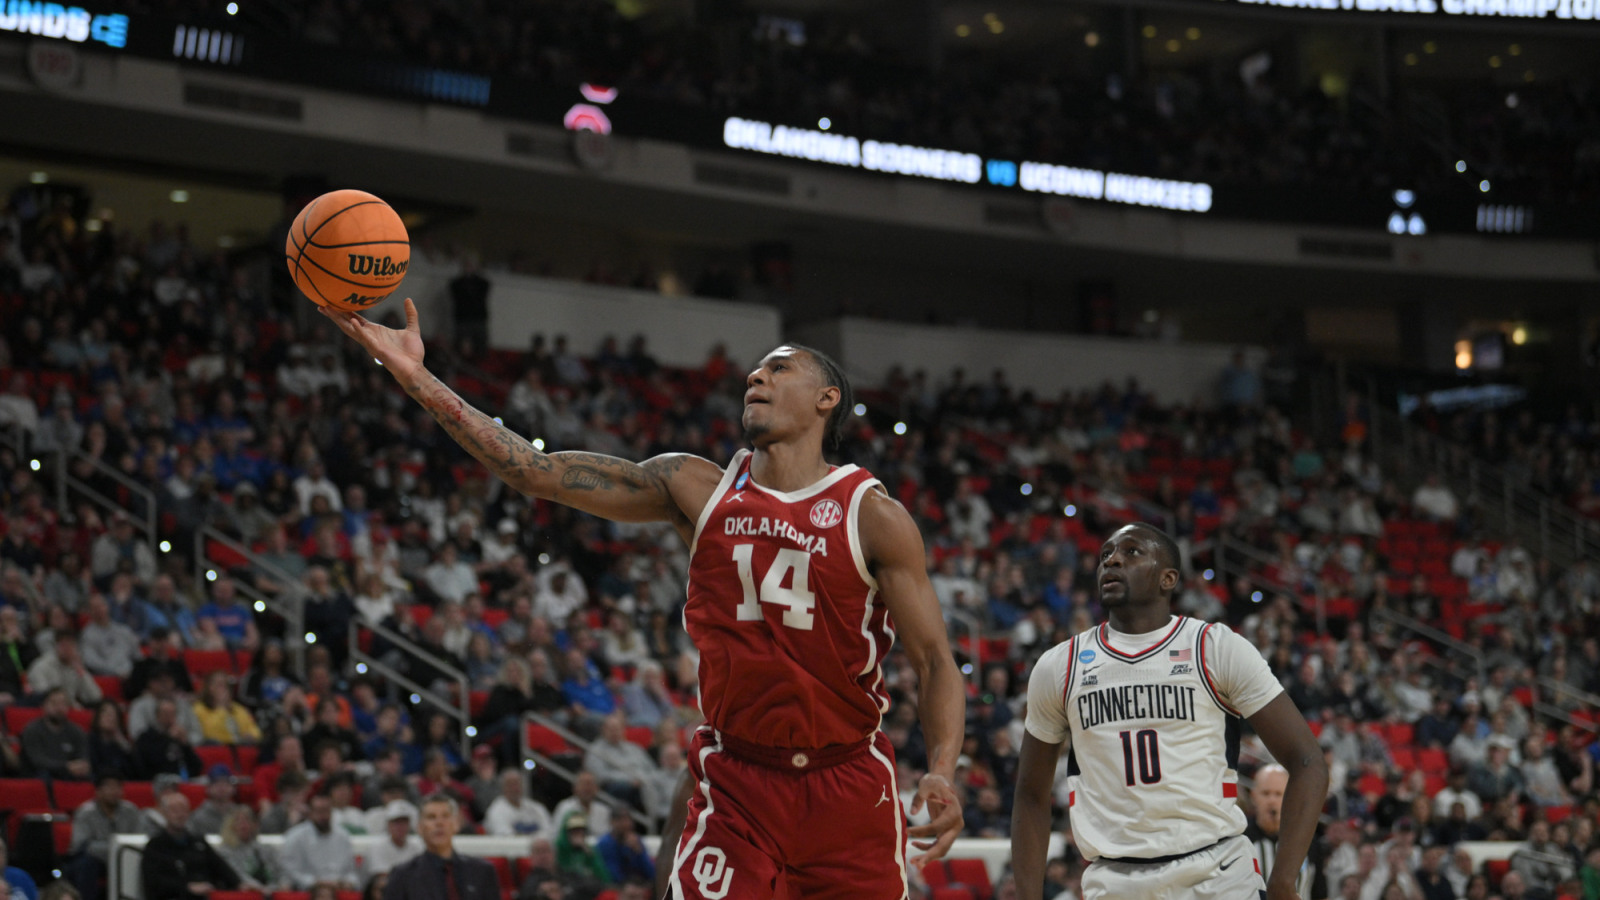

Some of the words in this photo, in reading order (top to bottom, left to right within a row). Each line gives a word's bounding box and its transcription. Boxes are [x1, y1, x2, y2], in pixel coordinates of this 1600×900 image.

[1442, 0, 1600, 20] CHAMPIO
[724, 117, 861, 166] OKLAHOMA
[862, 141, 982, 183] SOONERS
[1019, 161, 1104, 199] UCONN
[1104, 172, 1213, 212] HUSKIES
[724, 517, 828, 557] OKLAHOMA
[812, 501, 842, 527] SEC
[732, 543, 816, 631] 14
[1078, 684, 1196, 730] CONNECTICUT
[1119, 729, 1162, 787] 10
[692, 846, 734, 900] OU
